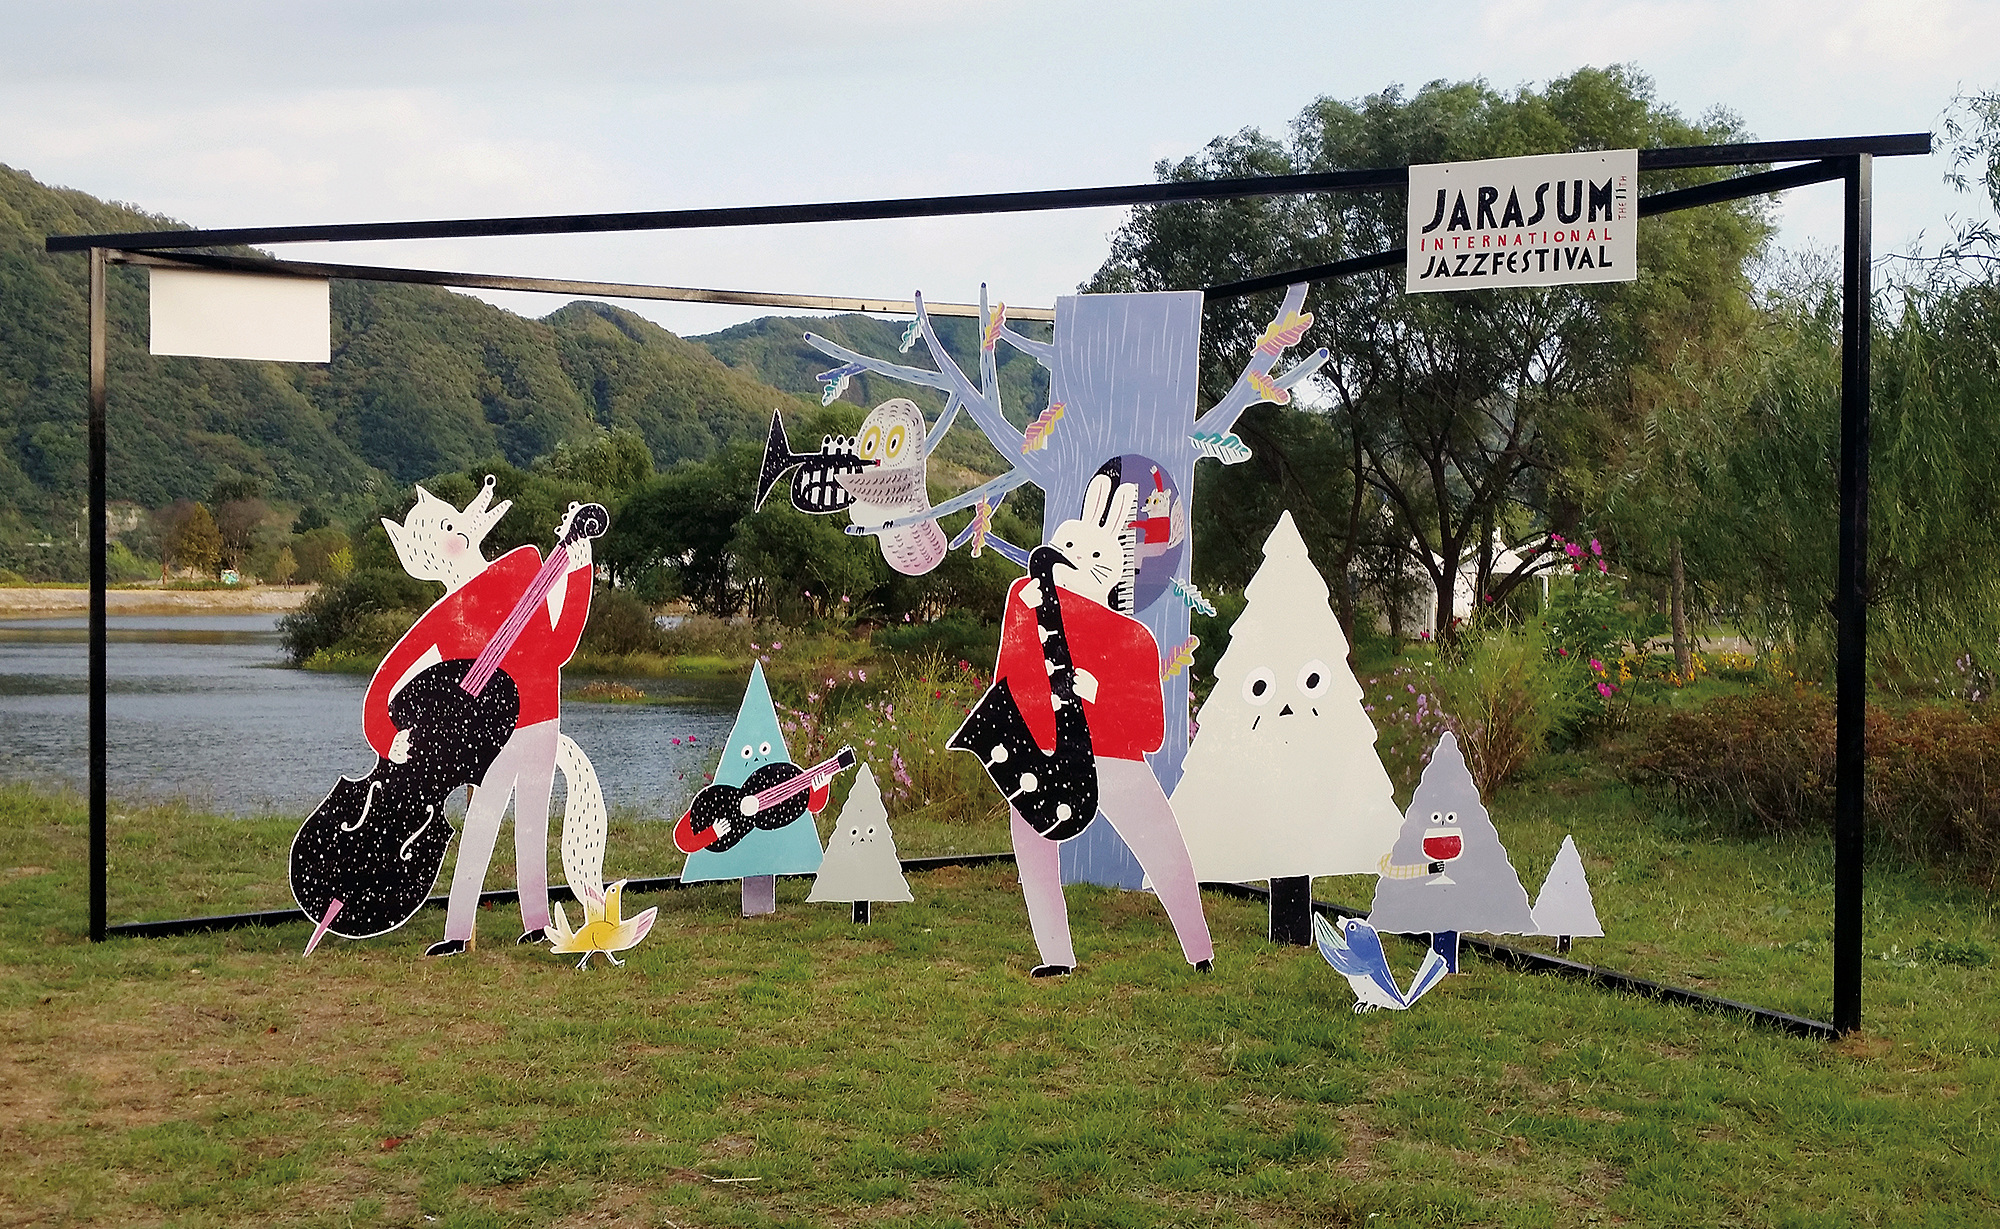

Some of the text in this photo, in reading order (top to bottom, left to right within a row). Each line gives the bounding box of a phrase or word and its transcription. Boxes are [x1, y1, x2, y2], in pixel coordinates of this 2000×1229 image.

[1421, 177, 1613, 235] JARASUM
[1618, 202, 1627, 220] THE
[1420, 228, 1612, 252] INTERNATIONAL
